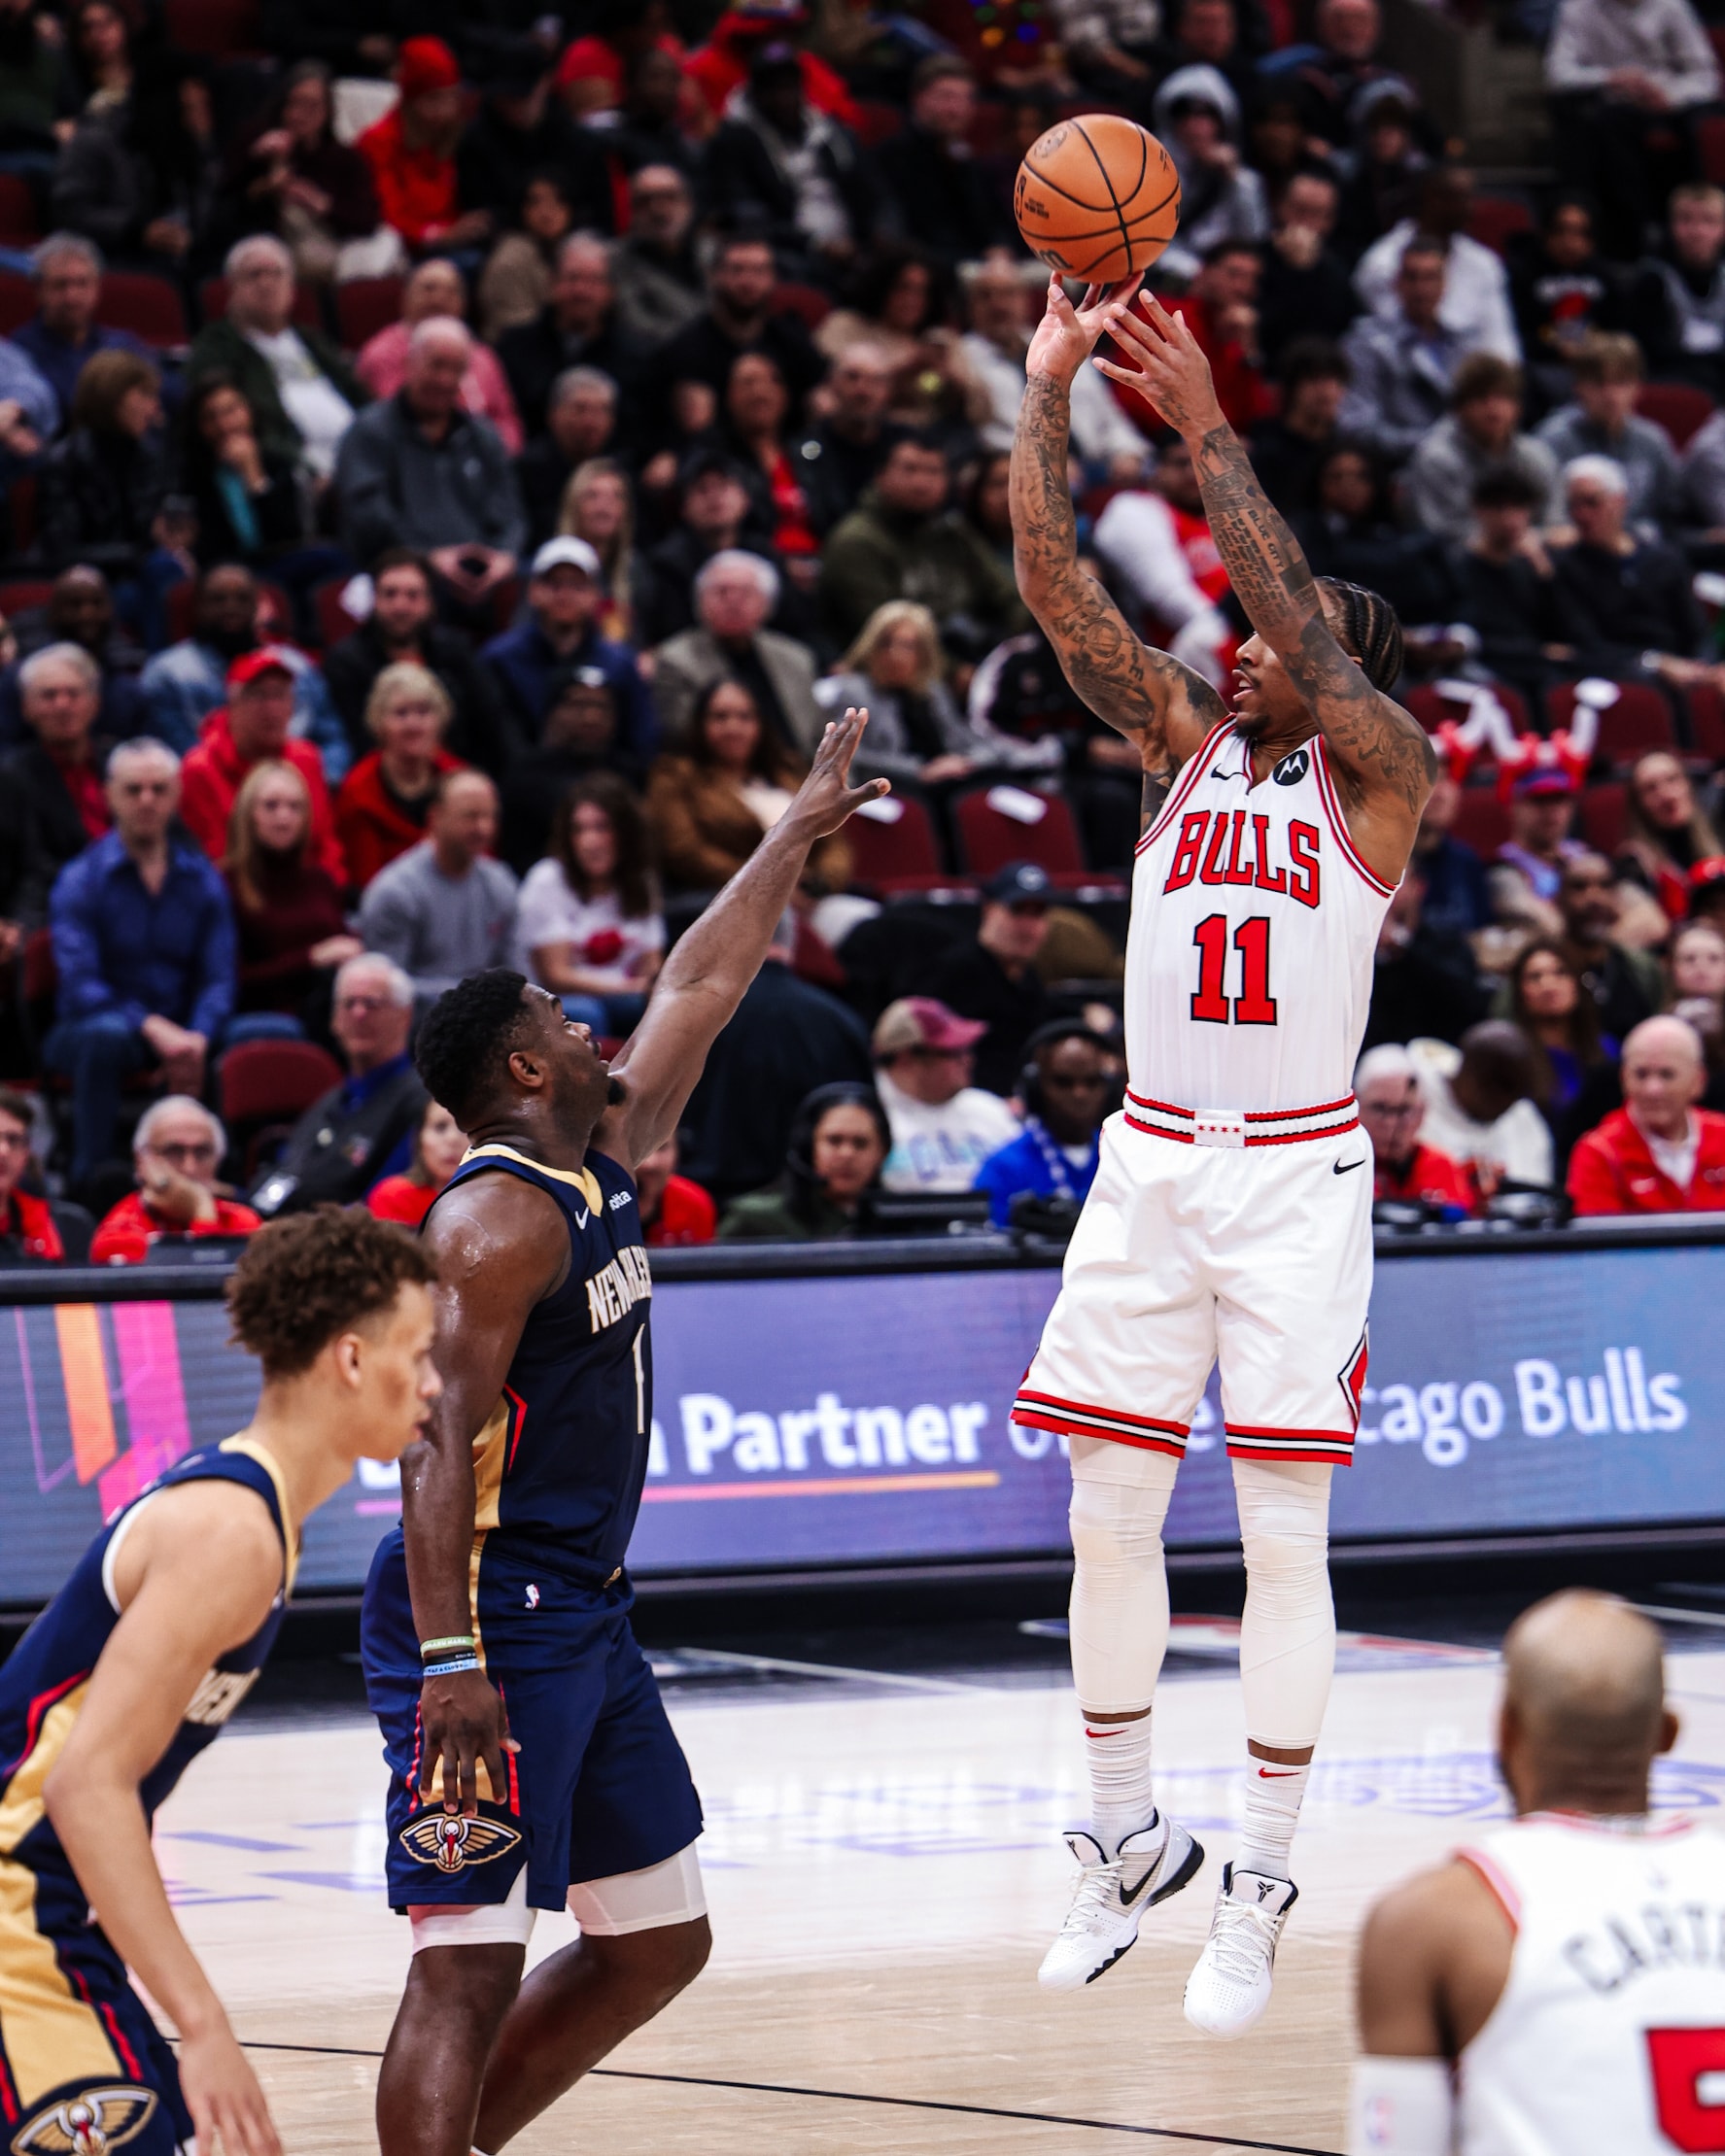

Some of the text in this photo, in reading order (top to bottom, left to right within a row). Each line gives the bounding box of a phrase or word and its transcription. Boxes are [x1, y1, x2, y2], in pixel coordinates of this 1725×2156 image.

[1248, 510, 1285, 567] BLUE CITY
[1162, 809, 1320, 909] BULLS
[1190, 913, 1277, 1026] 11
[678, 1391, 989, 1477] Partner
[1355, 1380, 1505, 1468] cago
[1513, 1346, 1689, 1438] Bulls
[1562, 1899, 1725, 1999] CART
